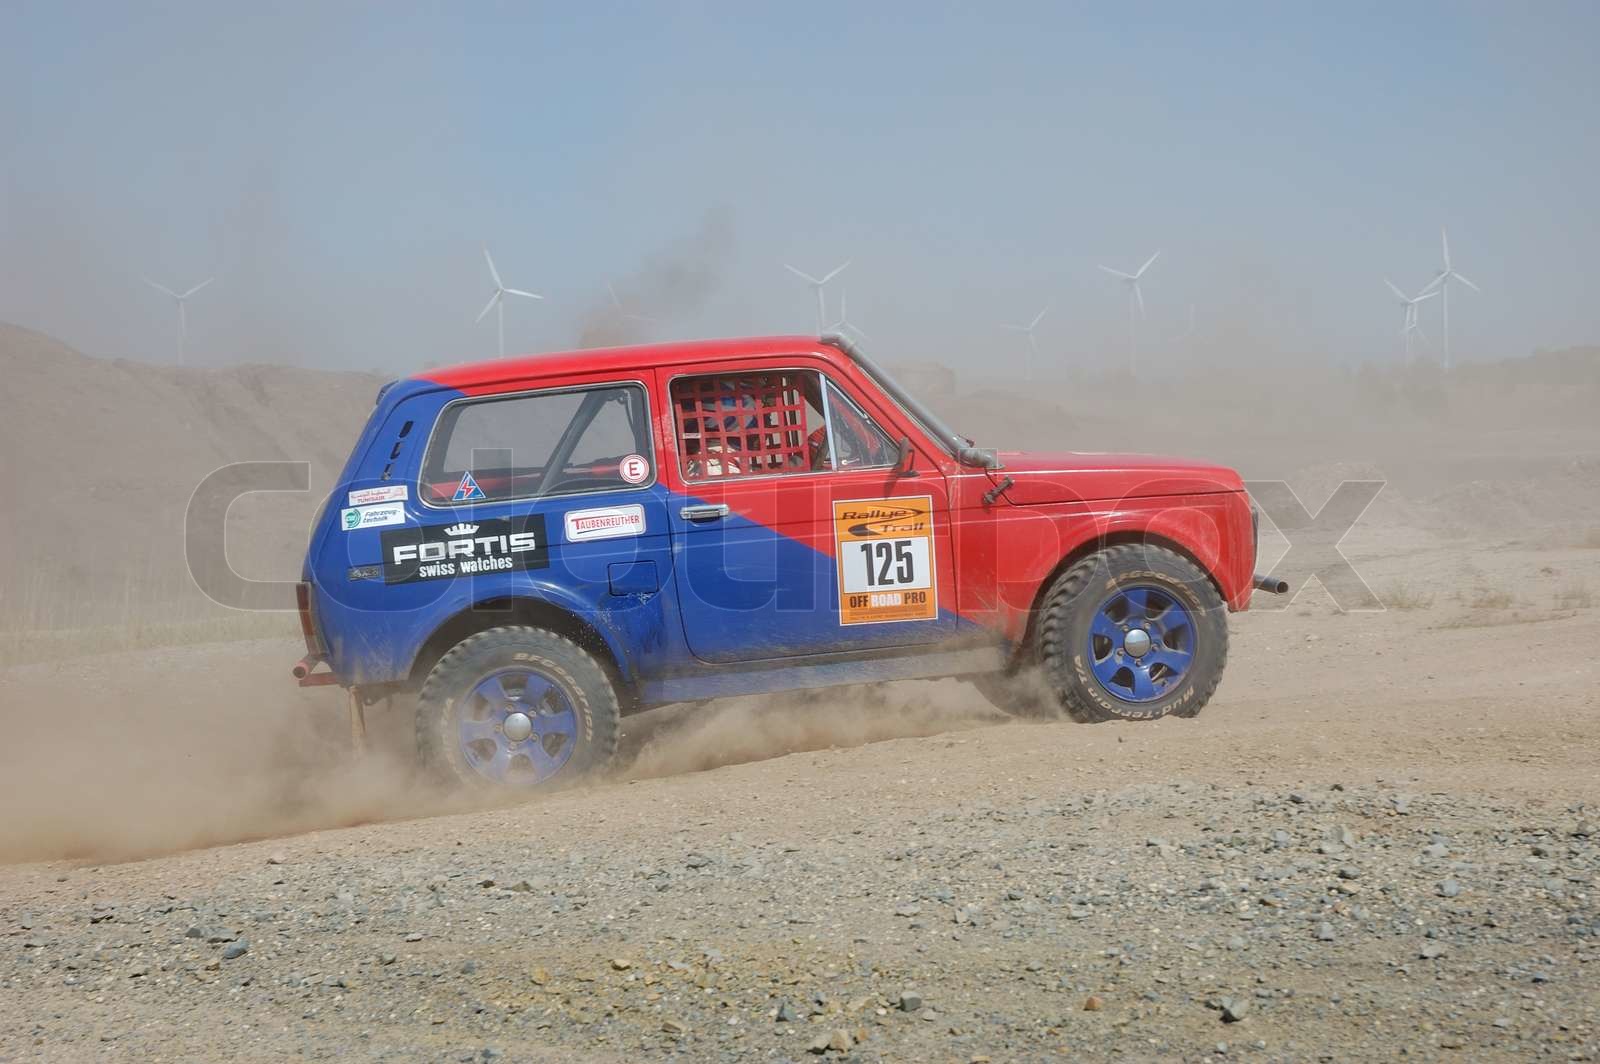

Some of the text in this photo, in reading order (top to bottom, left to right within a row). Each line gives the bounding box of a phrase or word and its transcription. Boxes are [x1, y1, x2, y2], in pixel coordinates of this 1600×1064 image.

[628, 461, 640, 476] E
[842, 509, 907, 520] Rallye
[880, 522, 924, 533] Trail
[393, 532, 536, 564] FORTIS
[419, 556, 513, 577] swiss watches
[860, 540, 914, 586] 125
[849, 592, 926, 608] OFF ROAD PRO
